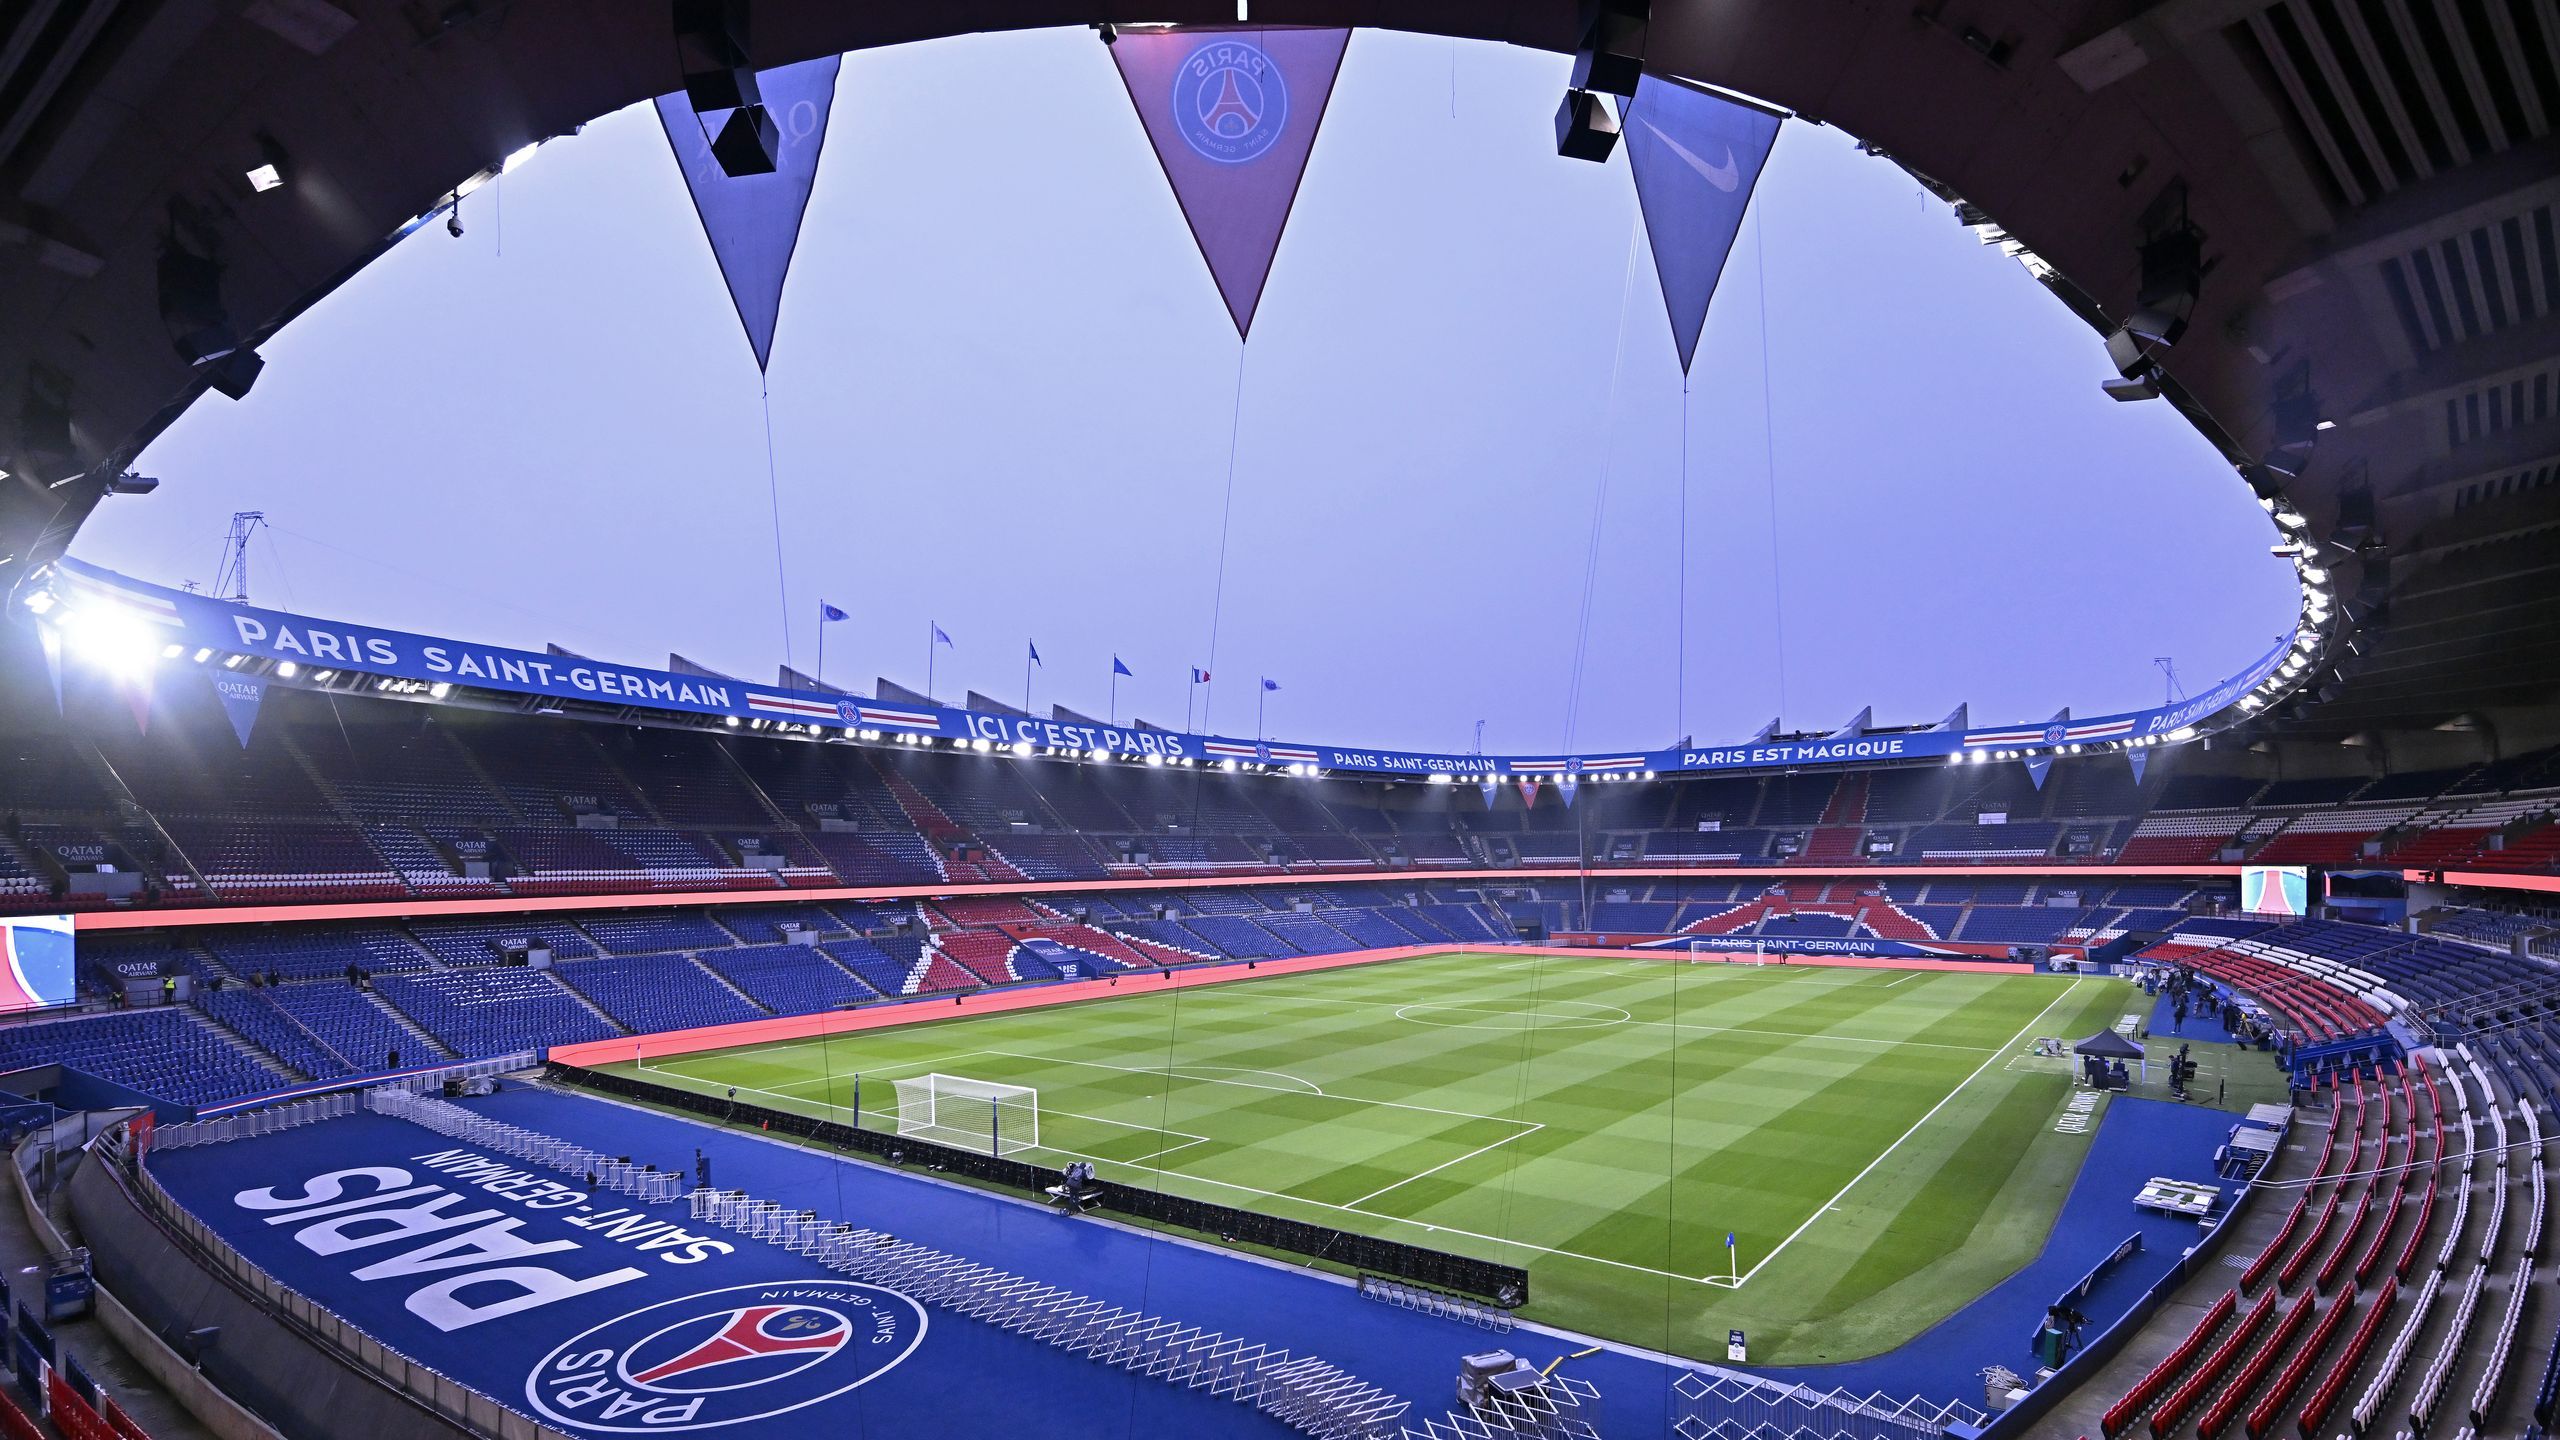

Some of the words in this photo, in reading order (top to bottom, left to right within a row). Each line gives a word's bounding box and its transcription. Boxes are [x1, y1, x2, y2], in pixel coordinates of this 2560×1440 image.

[233, 614, 398, 665] PARIS
[423, 646, 732, 708] SAINT-GERMAIN
[218, 681, 258, 696] QATAR
[2148, 706, 2188, 733] PARIS
[965, 714, 1008, 742] ICI
[1016, 720, 1098, 749] C'EST
[1103, 729, 1184, 756] PARIS
[1684, 749, 1746, 766] PARIS
[1752, 747, 1794, 762] EST
[1798, 739, 1904, 759] MAGIQUE
[1333, 752, 1378, 767] PARIS
[1382, 755, 1496, 772] SAINT-GERMAIN
[563, 795, 598, 806] QATAR
[811, 803, 838, 812] QATAR
[455, 840, 486, 850] QATAR
[738, 838, 760, 846] QATAR
[58, 845, 103, 857] QATAR
[781, 922, 800, 930] QATAR
[501, 938, 528, 947] QATAR
[117, 962, 157, 973] QATAR
[234, 1166, 648, 1332] PARIS
[761, 1289, 872, 1306] GERMAIN
[871, 1310, 897, 1344] SAINT
[548, 1348, 706, 1424] PARIS
